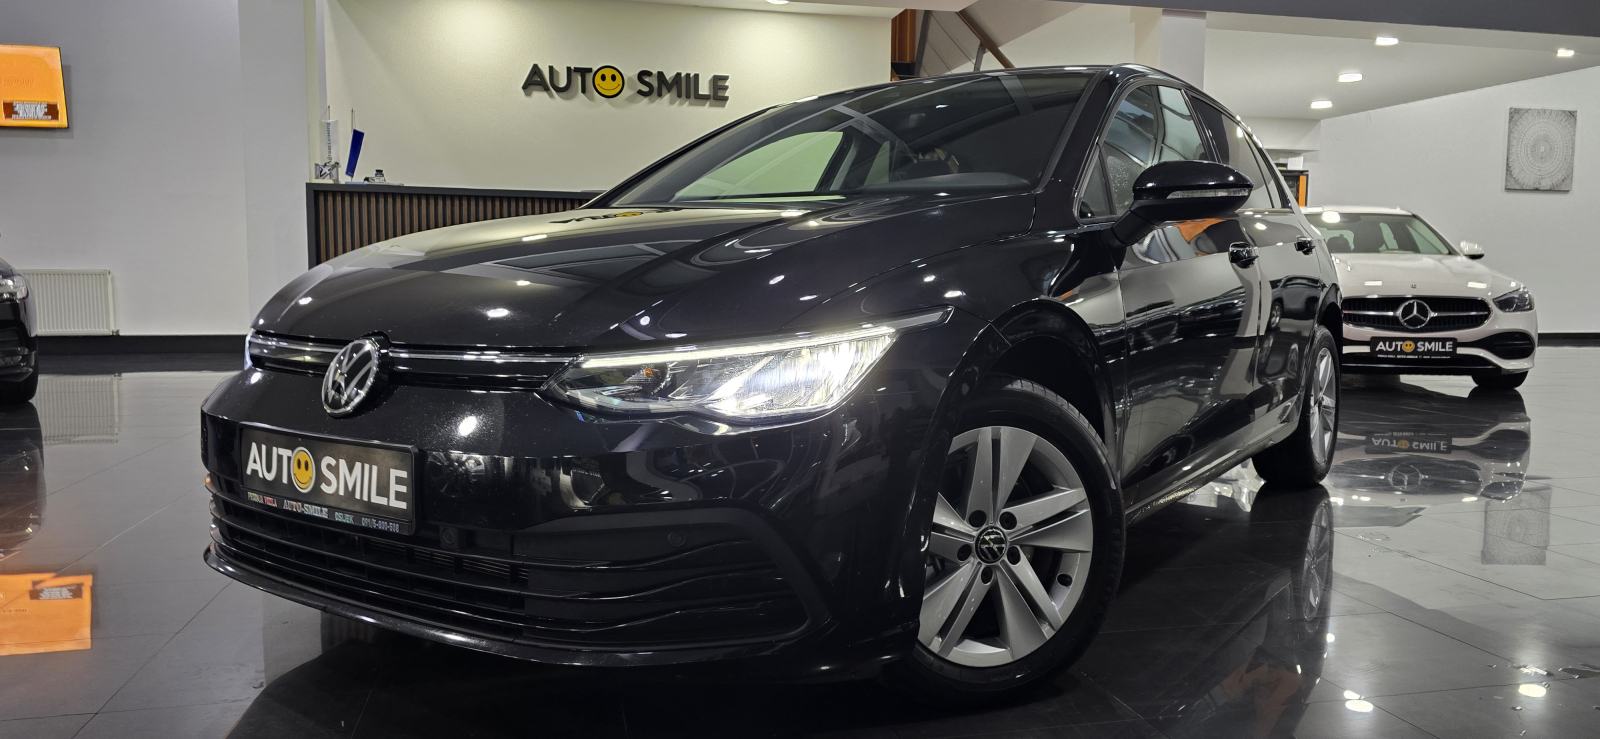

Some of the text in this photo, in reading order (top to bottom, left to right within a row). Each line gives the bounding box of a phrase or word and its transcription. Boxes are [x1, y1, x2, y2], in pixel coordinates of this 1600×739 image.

[636, 69, 730, 101] SMILE
[1416, 341, 1453, 352] SMILE
[320, 455, 408, 510] SMILE
[283, 499, 329, 519] AUTO-SMILE
